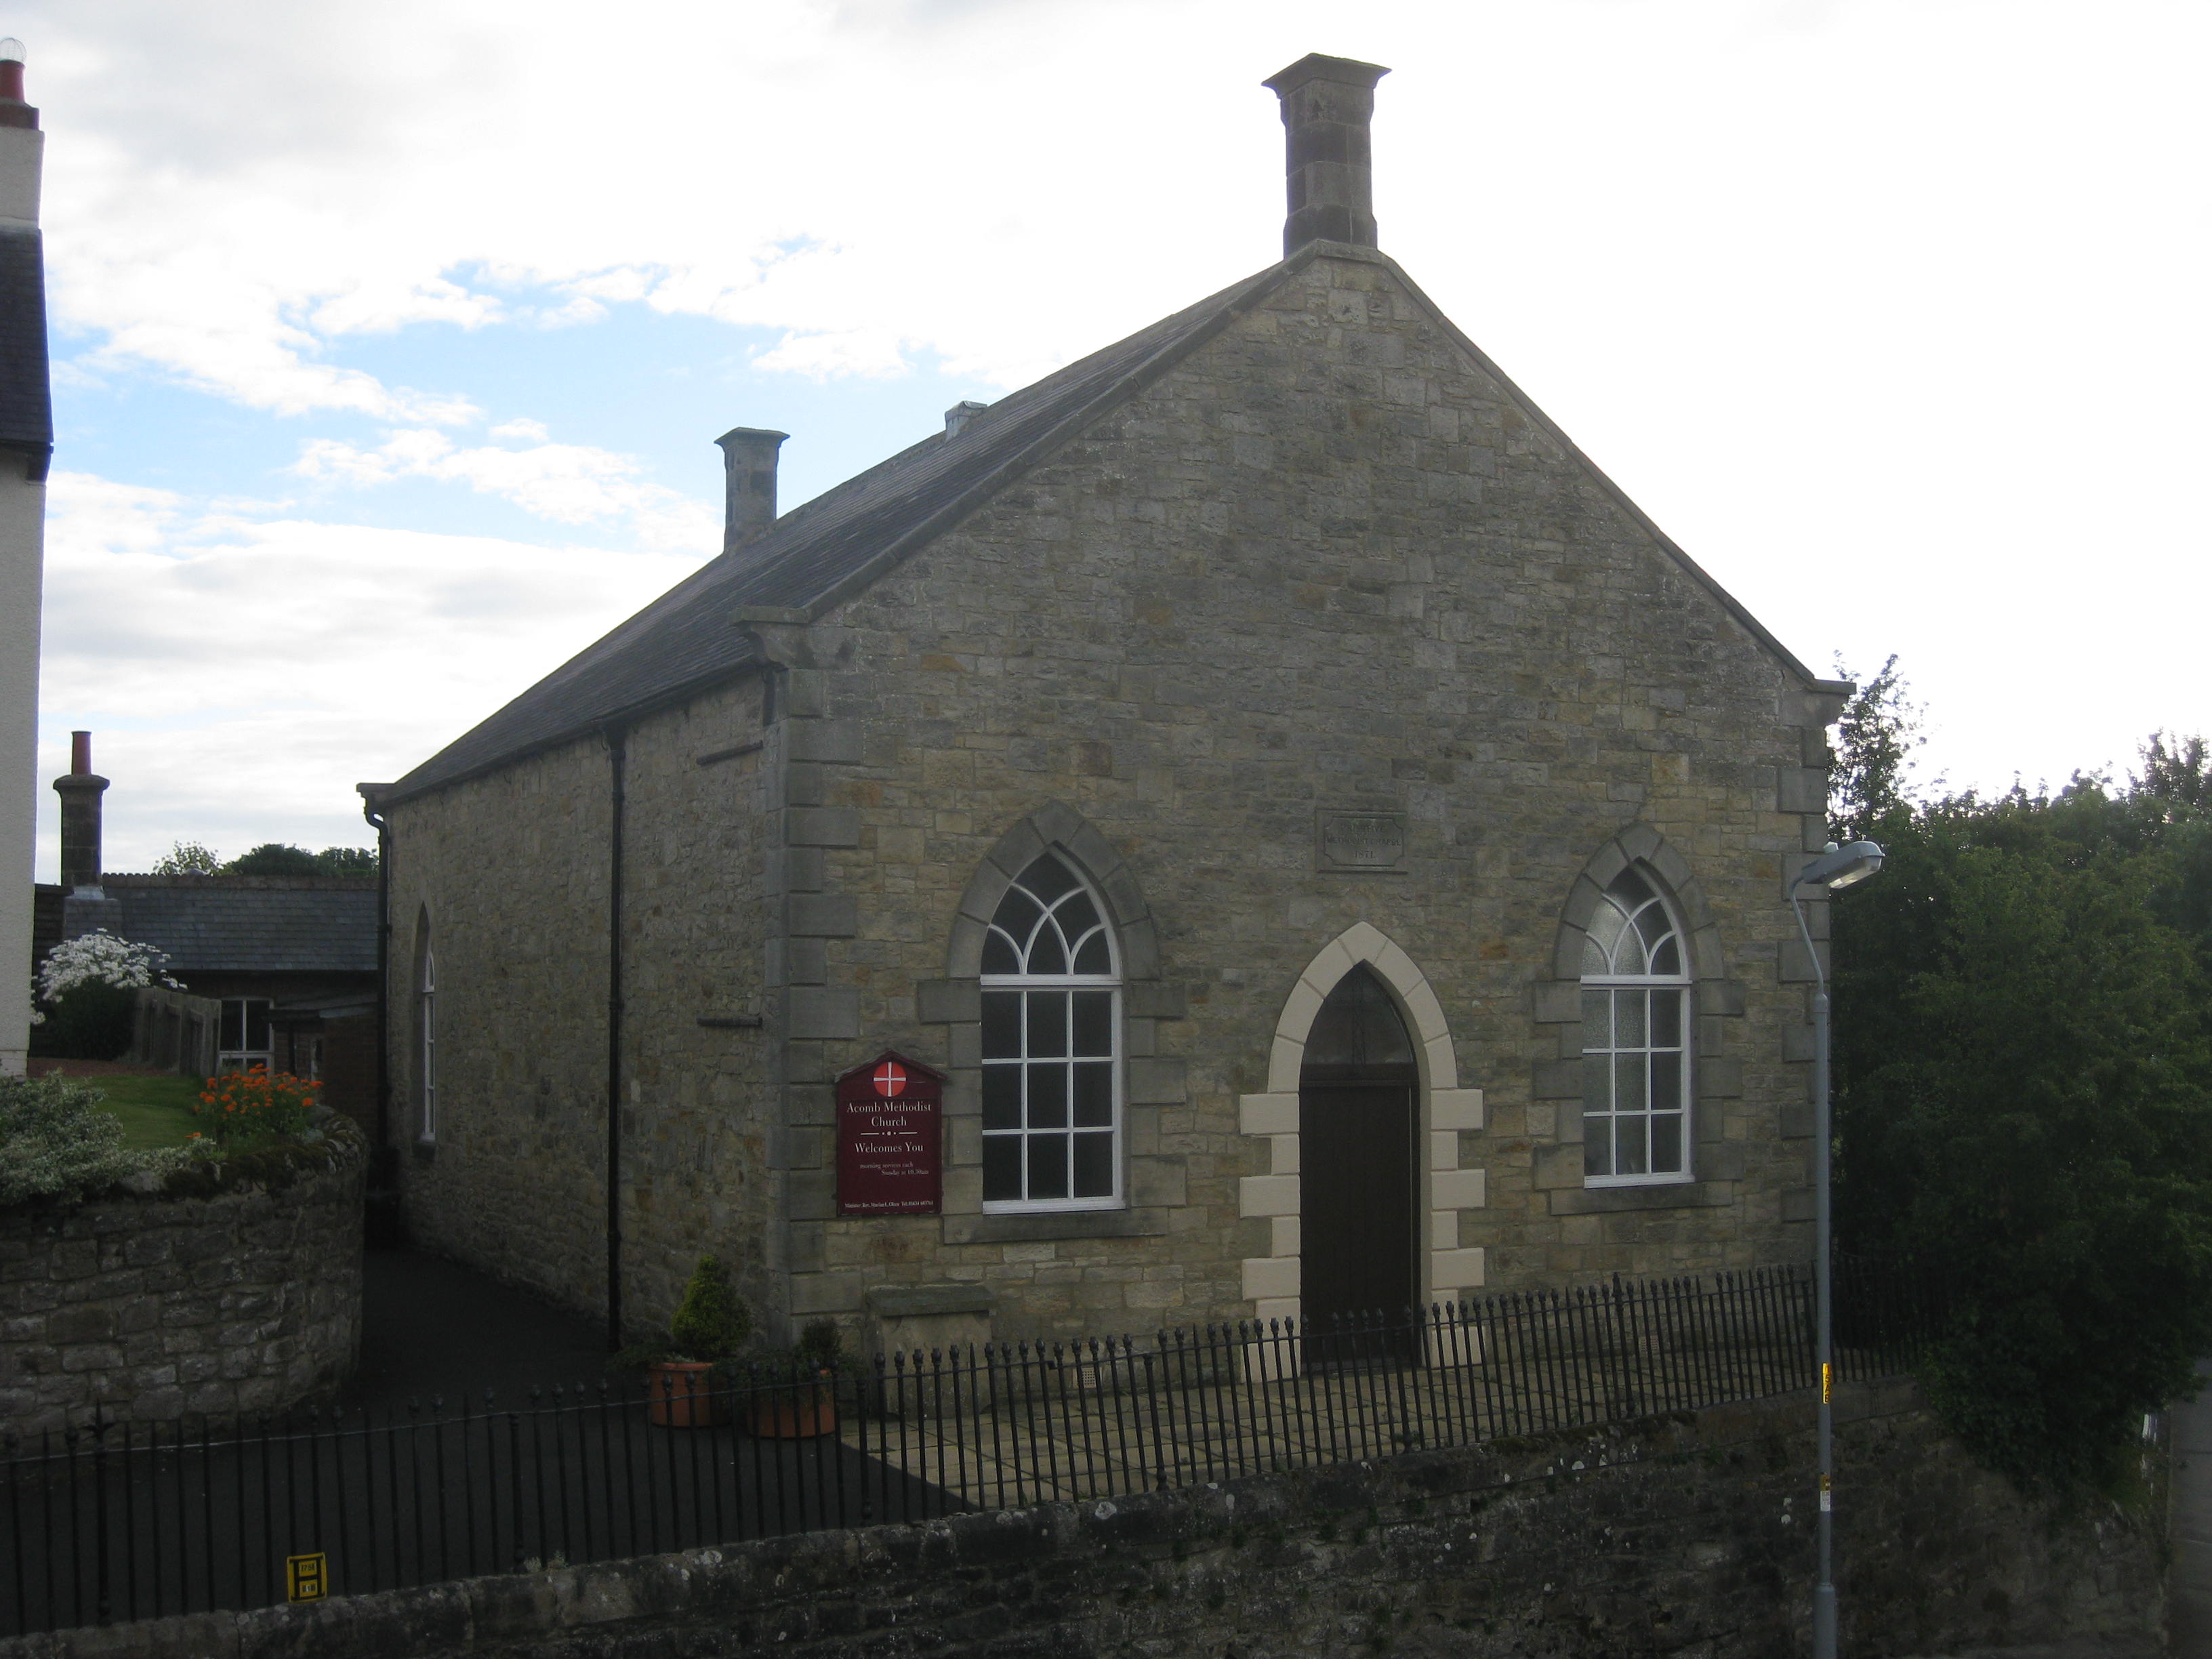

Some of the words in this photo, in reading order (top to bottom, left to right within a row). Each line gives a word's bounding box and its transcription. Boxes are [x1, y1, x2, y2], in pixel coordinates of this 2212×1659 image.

[847, 1102, 881, 1113] Acomb
[884, 1101, 931, 1112] Methodist
[871, 1116, 907, 1127] Church
[855, 1143, 902, 1153] Welcomes
[905, 1142, 924, 1152] You
